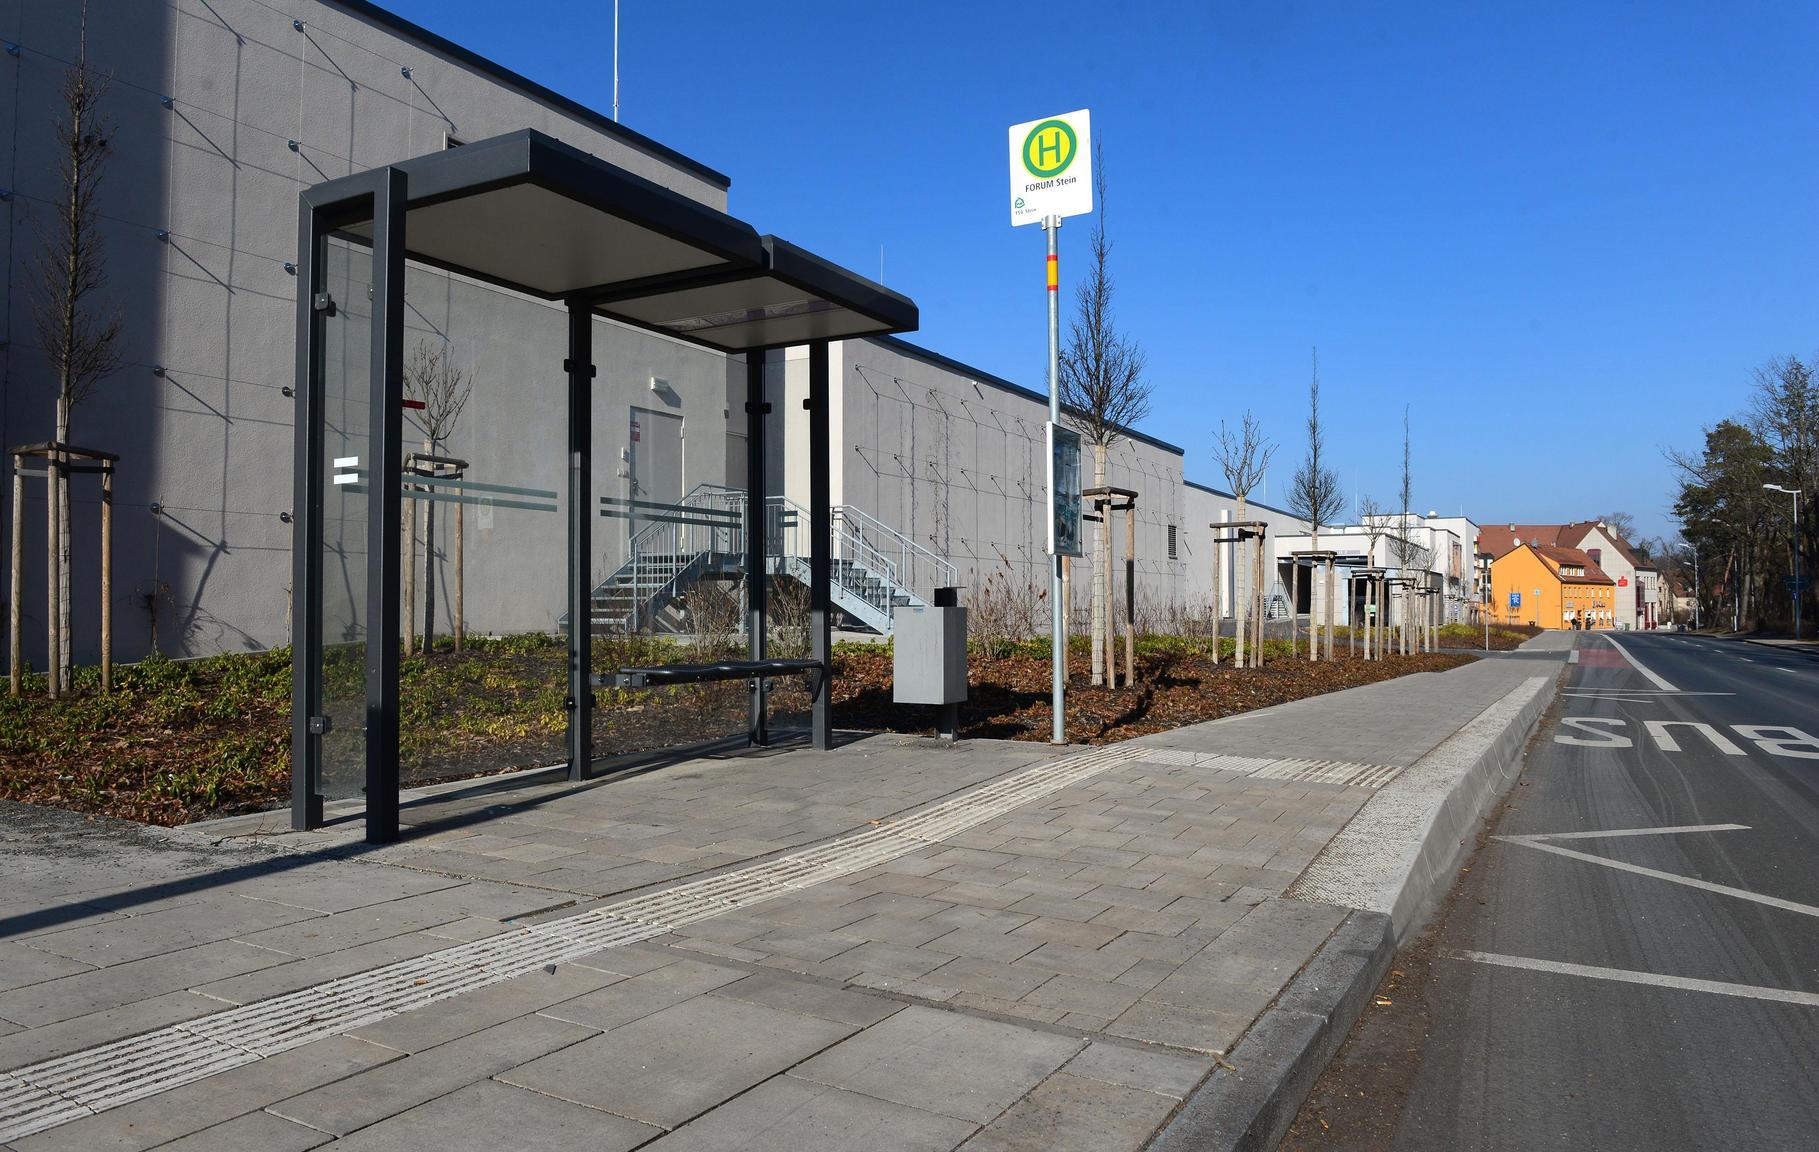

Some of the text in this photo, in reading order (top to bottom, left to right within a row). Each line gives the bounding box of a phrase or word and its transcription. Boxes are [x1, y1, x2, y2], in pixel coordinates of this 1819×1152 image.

[1039, 131, 1060, 166] H
[1025, 176, 1077, 192] FORUM Stein
[1554, 717, 1819, 759] BUS
